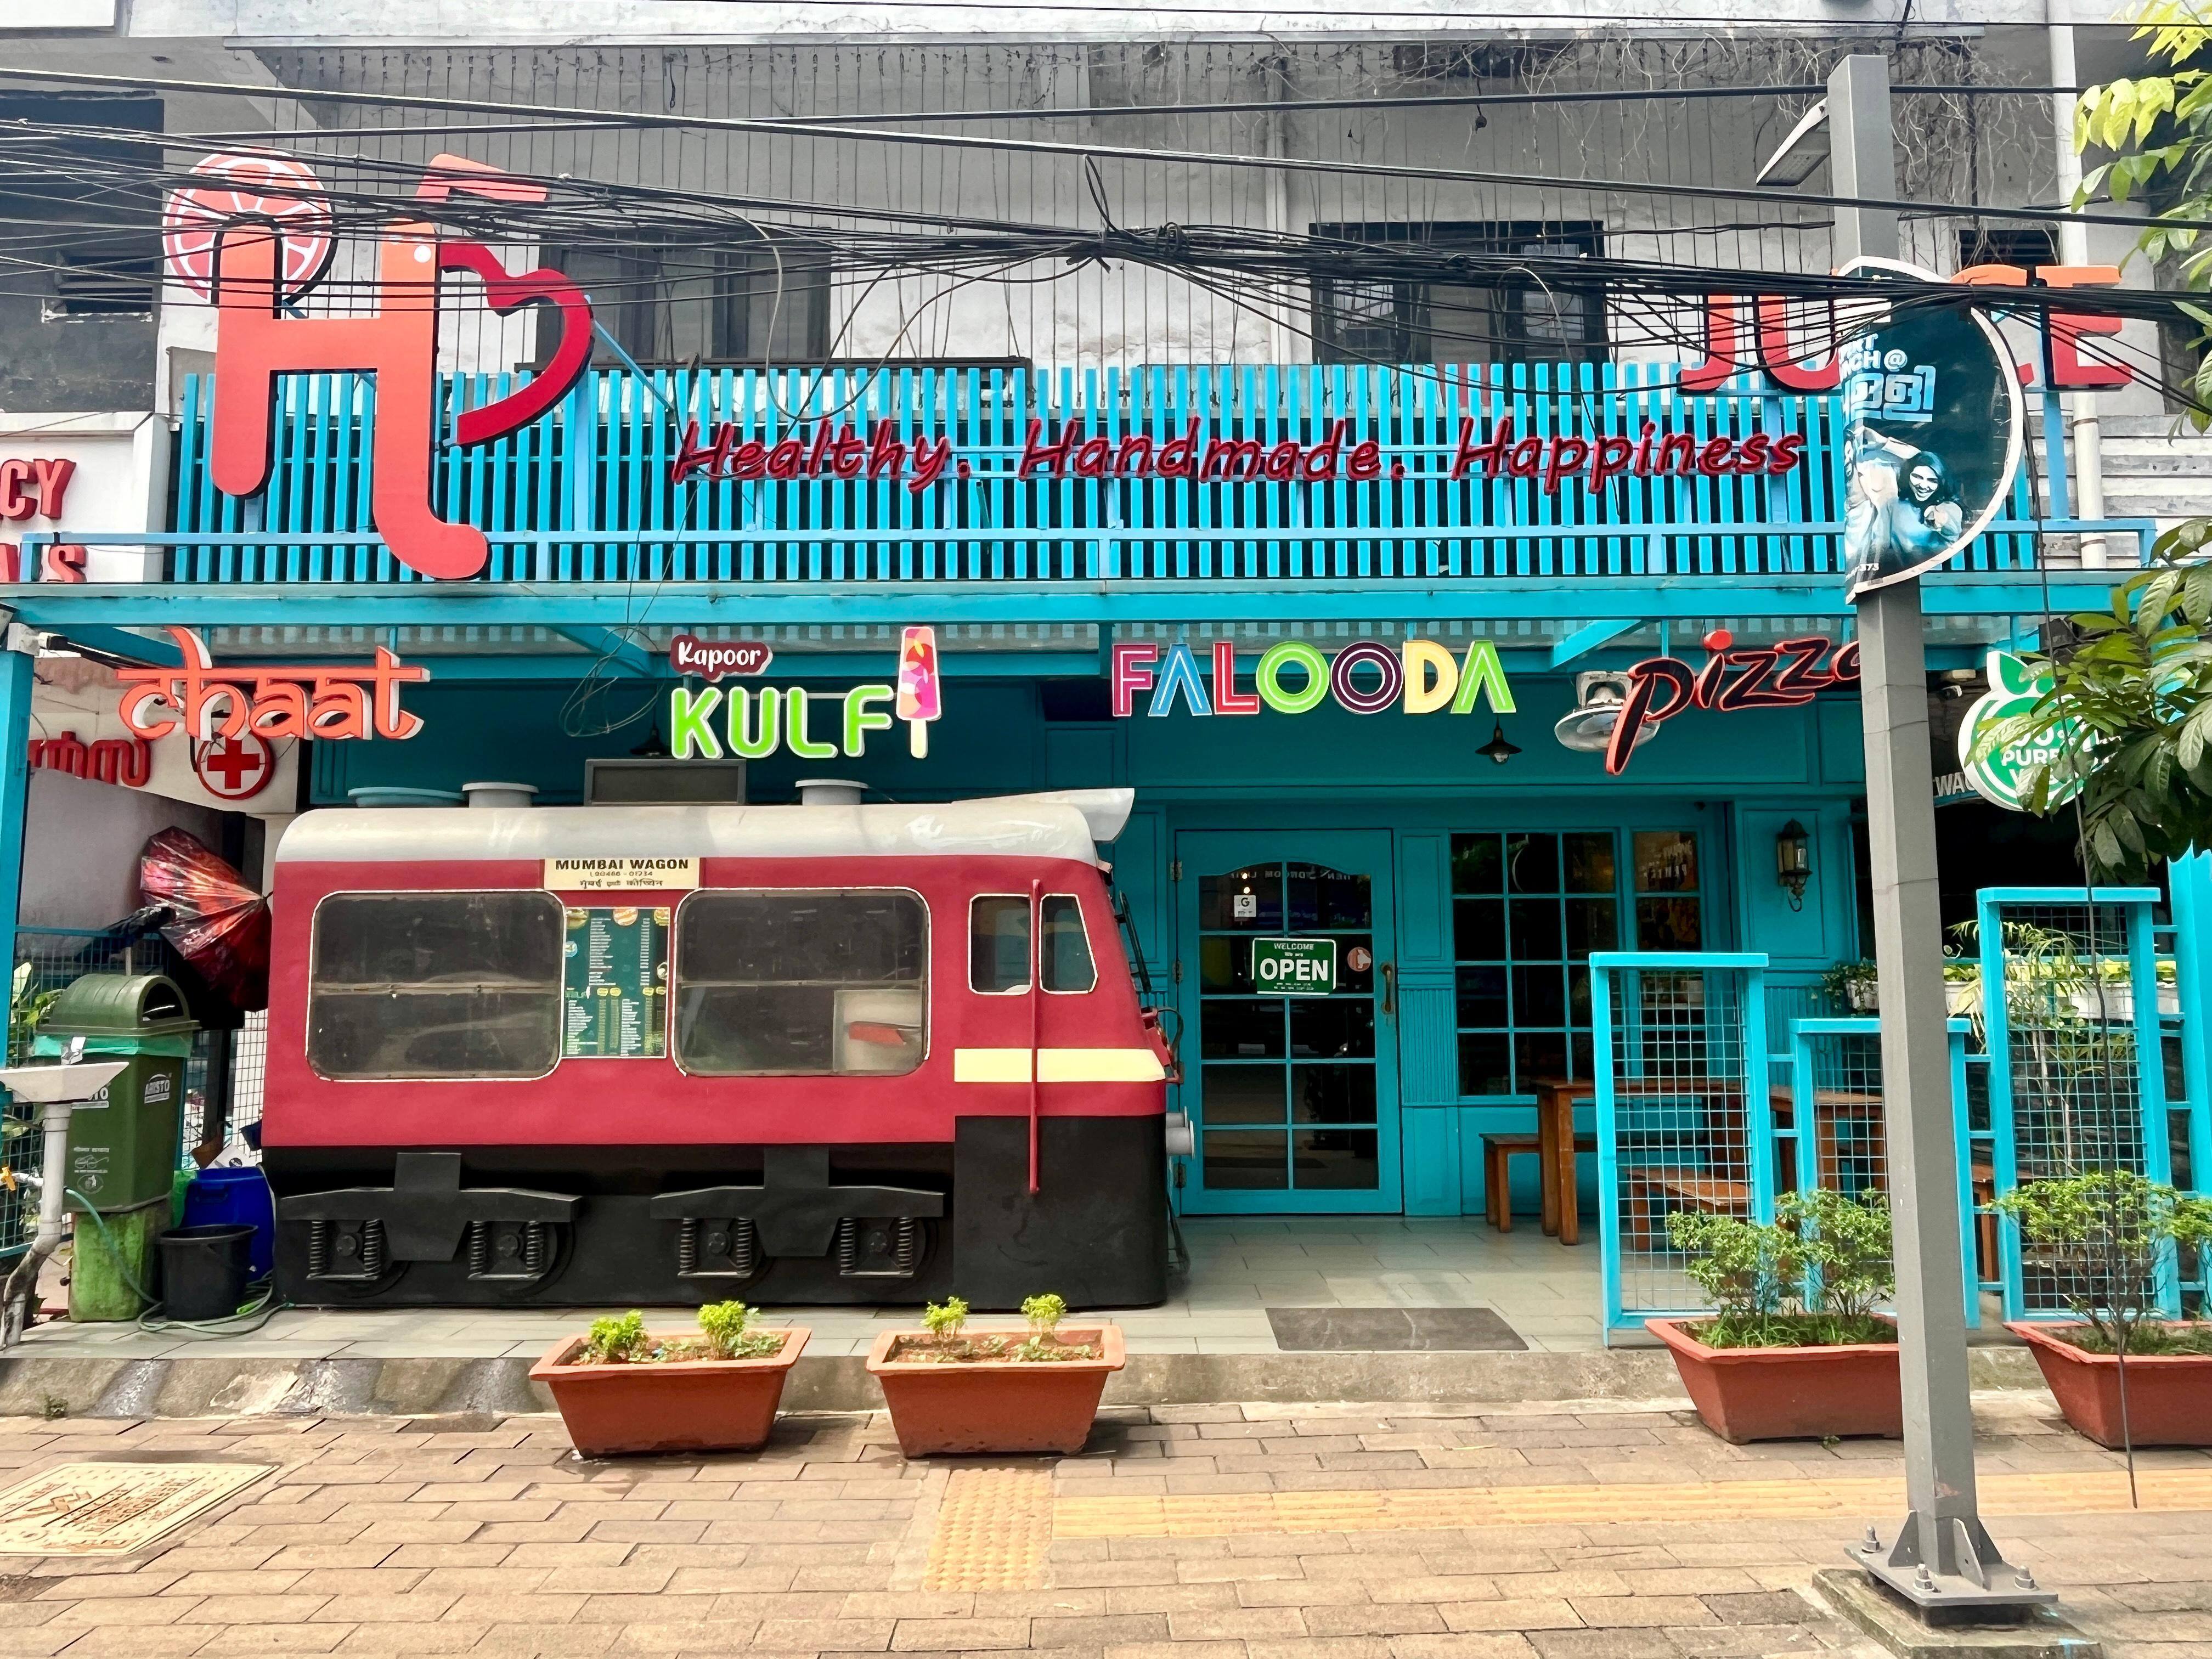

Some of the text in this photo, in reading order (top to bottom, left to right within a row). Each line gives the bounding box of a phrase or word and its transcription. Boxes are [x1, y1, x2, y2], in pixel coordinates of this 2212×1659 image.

[672, 415, 1805, 495] Healthy. Handmade. Happiness
[116, 627, 430, 740] chaat
[678, 641, 761, 672] Kapoor
[1112, 640, 1516, 717] FALOODA
[556, 859, 689, 870] MUMBAI WAGON
[1260, 958, 1328, 981] OPEN
